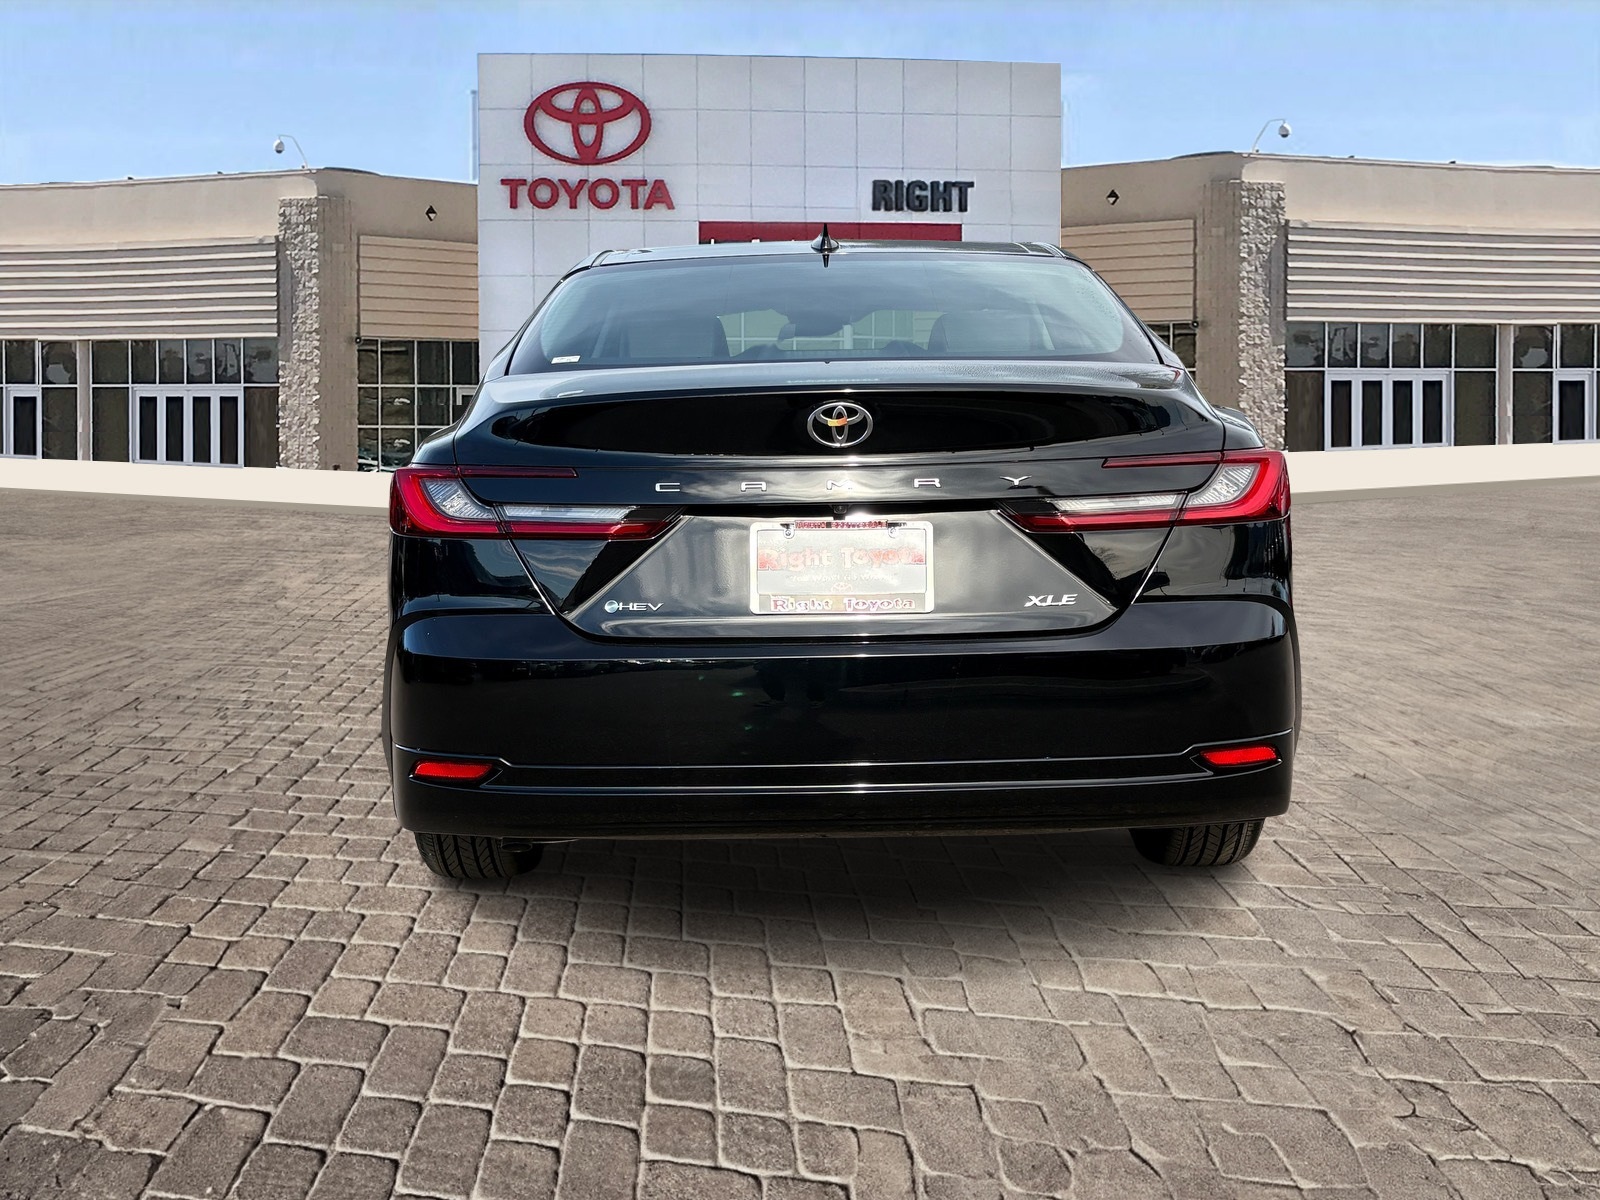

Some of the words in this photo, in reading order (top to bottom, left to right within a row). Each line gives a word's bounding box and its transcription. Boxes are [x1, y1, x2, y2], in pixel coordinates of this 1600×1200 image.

[500, 179, 676, 210] TOYOTA
[872, 179, 975, 213] RIGHT
[655, 475, 1032, 492] CAMRY
[758, 546, 832, 571] Right
[619, 602, 664, 611] HEV
[770, 597, 833, 612] Right
[843, 597, 916, 612] Toyota
[1024, 594, 1078, 607] XLE
